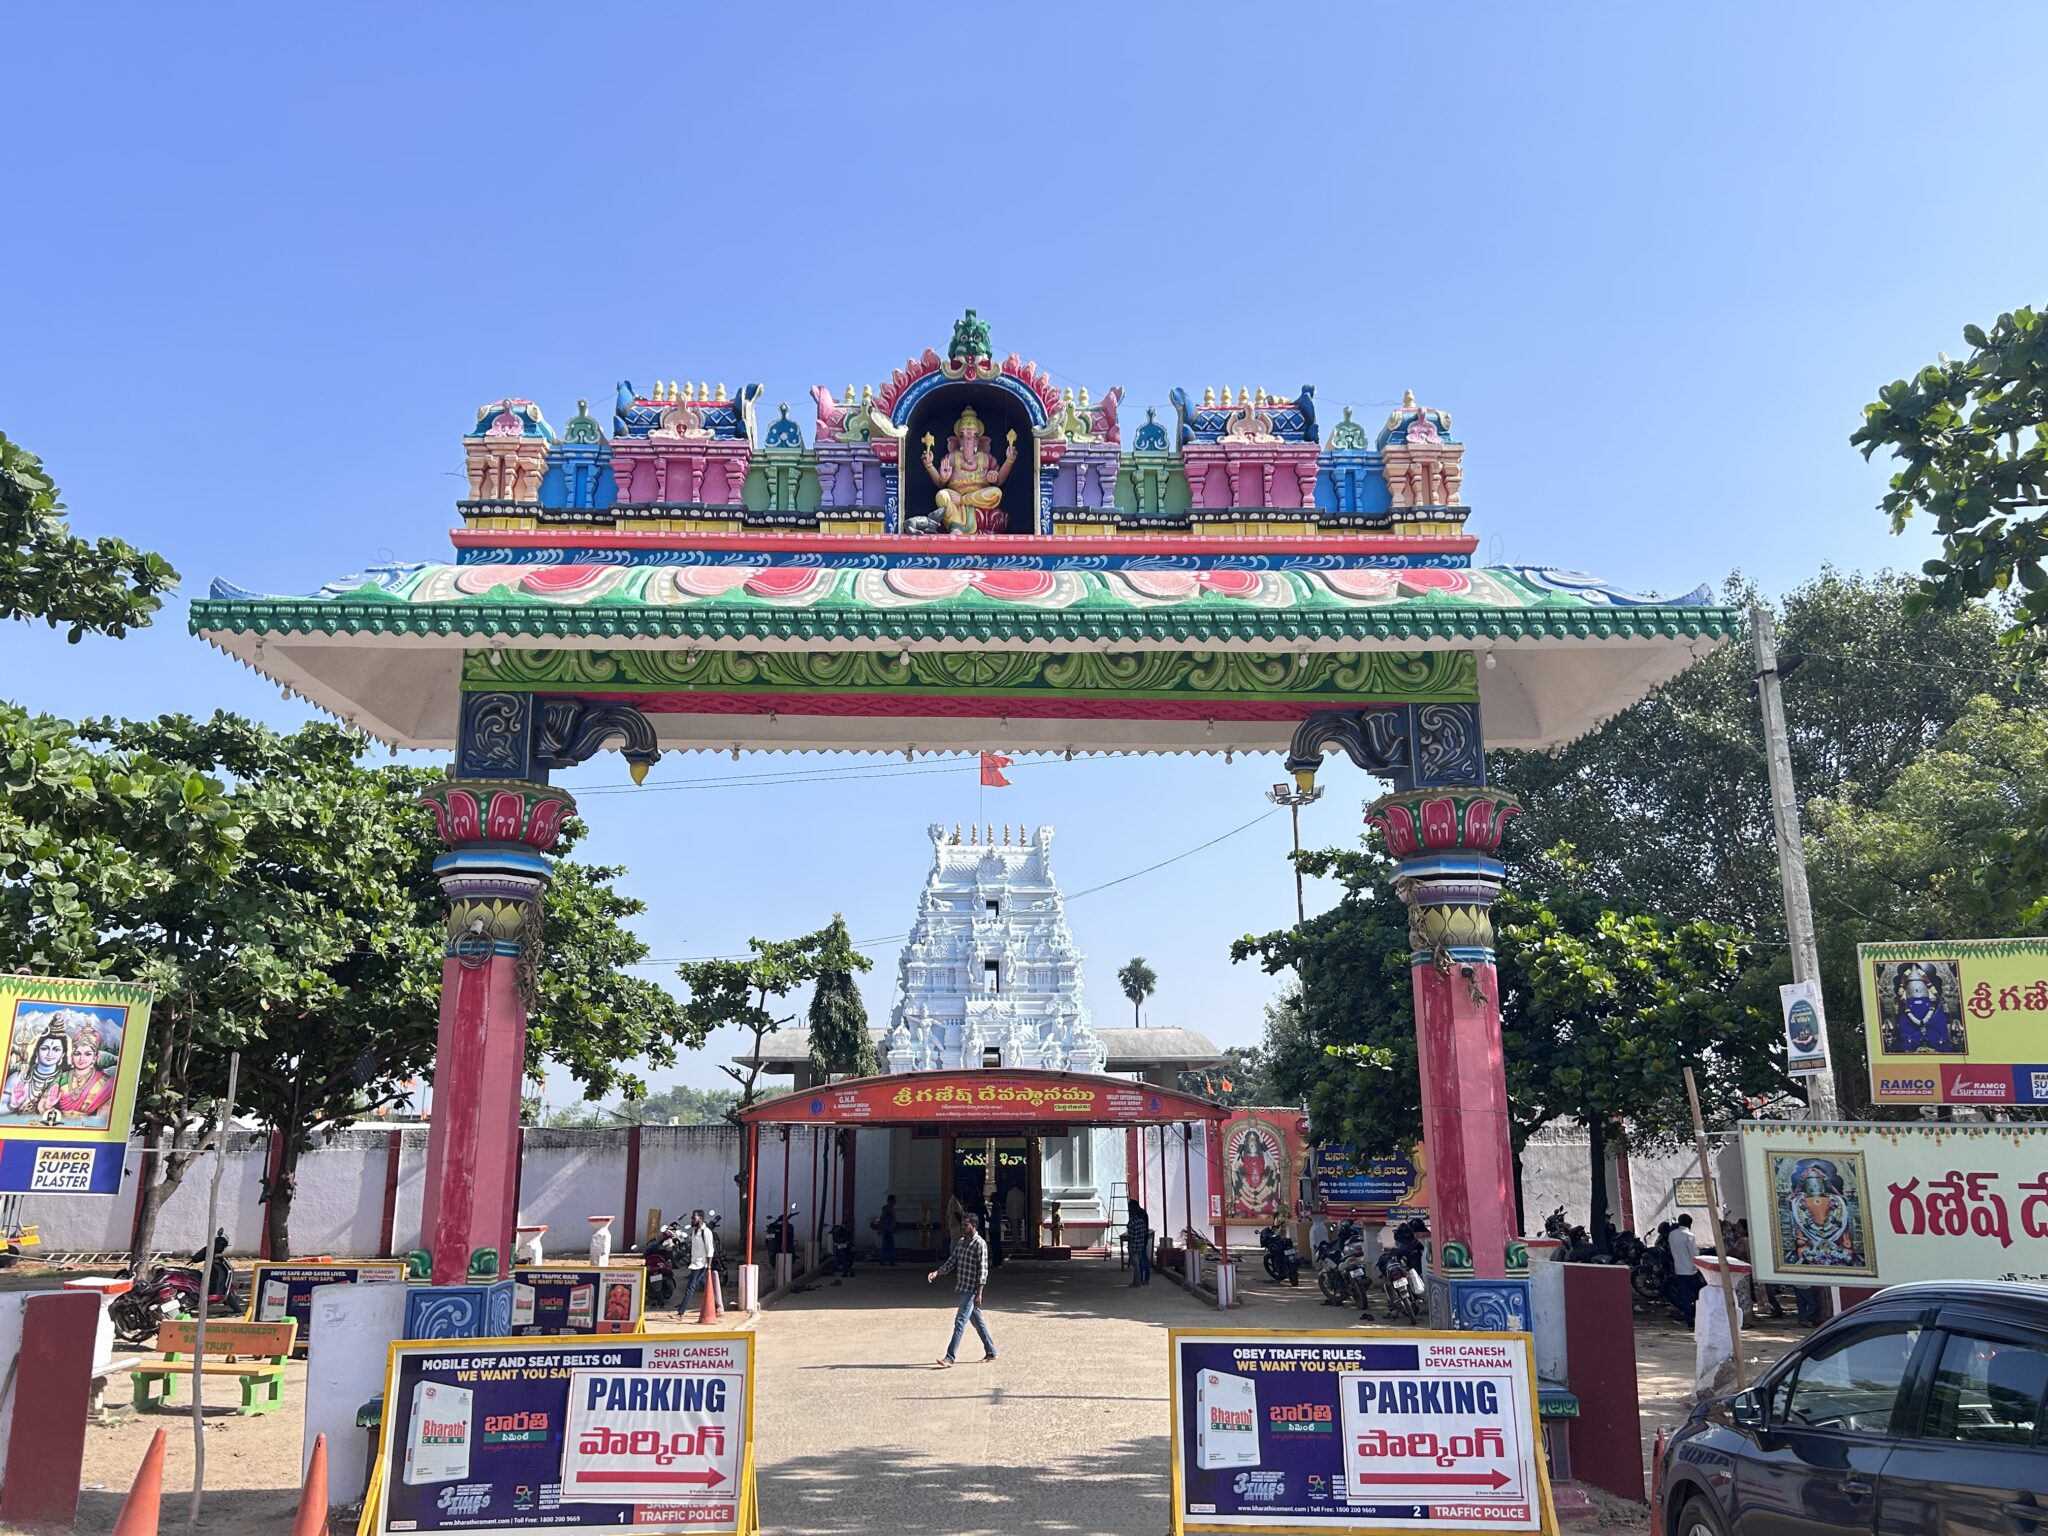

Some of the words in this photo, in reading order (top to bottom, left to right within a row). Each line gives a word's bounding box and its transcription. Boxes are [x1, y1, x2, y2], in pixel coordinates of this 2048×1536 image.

[1968, 982, 1996, 1019] శ్రీ
[1880, 1080, 1934, 1088] RAMCO
[892, 1087, 915, 1106] శ్రీ
[916, 1086, 973, 1104] గణేష్
[978, 1086, 1096, 1107] దేవస్థానము
[42, 1152, 90, 1160] RAMCO
[37, 1162, 90, 1174] SUPER
[35, 1176, 88, 1188] PLASTER
[1888, 1170, 2014, 1249] గణేష్
[654, 1349, 679, 1358] SHRI
[683, 1348, 729, 1357] GANESH
[1233, 1349, 1267, 1359] OBEY
[1269, 1349, 1320, 1360] TRAFFIC
[1323, 1350, 1366, 1360] RULES.
[1430, 1346, 1456, 1355] SHRI
[1459, 1347, 1505, 1356] GANESH
[422, 1359, 469, 1370] MOBILE
[472, 1358, 497, 1369] OFF
[499, 1357, 526, 1368] AND
[528, 1356, 561, 1367] SEAT
[563, 1356, 600, 1367] BELTS
[603, 1354, 621, 1365] ON
[648, 1360, 734, 1369] DEVASTHANAM
[1236, 1361, 1256, 1371] WE
[1259, 1361, 1297, 1371] WANT
[1299, 1361, 1326, 1372] YOU
[1425, 1359, 1512, 1368] DEVASTHANAM
[457, 1370, 478, 1381] WE
[480, 1370, 519, 1381] WANT
[521, 1369, 547, 1380] YOU
[587, 1378, 726, 1412] PARKING
[1357, 1381, 1498, 1414] PARKING
[1211, 1406, 1253, 1424] Bharathi
[1270, 1403, 1332, 1424] భారతి
[423, 1420, 466, 1437] Bharathi
[484, 1411, 548, 1434] భారతి
[579, 1426, 725, 1465] పార్కింగ్
[1357, 1428, 1505, 1468] పార్కింగ్
[1233, 1473, 1249, 1494] 3
[1246, 1483, 1285, 1495] TIMES
[437, 1487, 455, 1509] 3
[451, 1494, 491, 1508] TIMES
[1244, 1493, 1275, 1501] BETTER
[447, 1507, 480, 1515] BETTER
[640, 1511, 686, 1521] TRAFFIC
[688, 1510, 728, 1520] POLICE
[1413, 1506, 1421, 1517] 2
[1435, 1506, 1482, 1517] TRAFFIC
[1484, 1508, 1525, 1518] POLICE
[440, 1518, 510, 1526] www.bharathicement.com
[618, 1512, 624, 1523] 1
